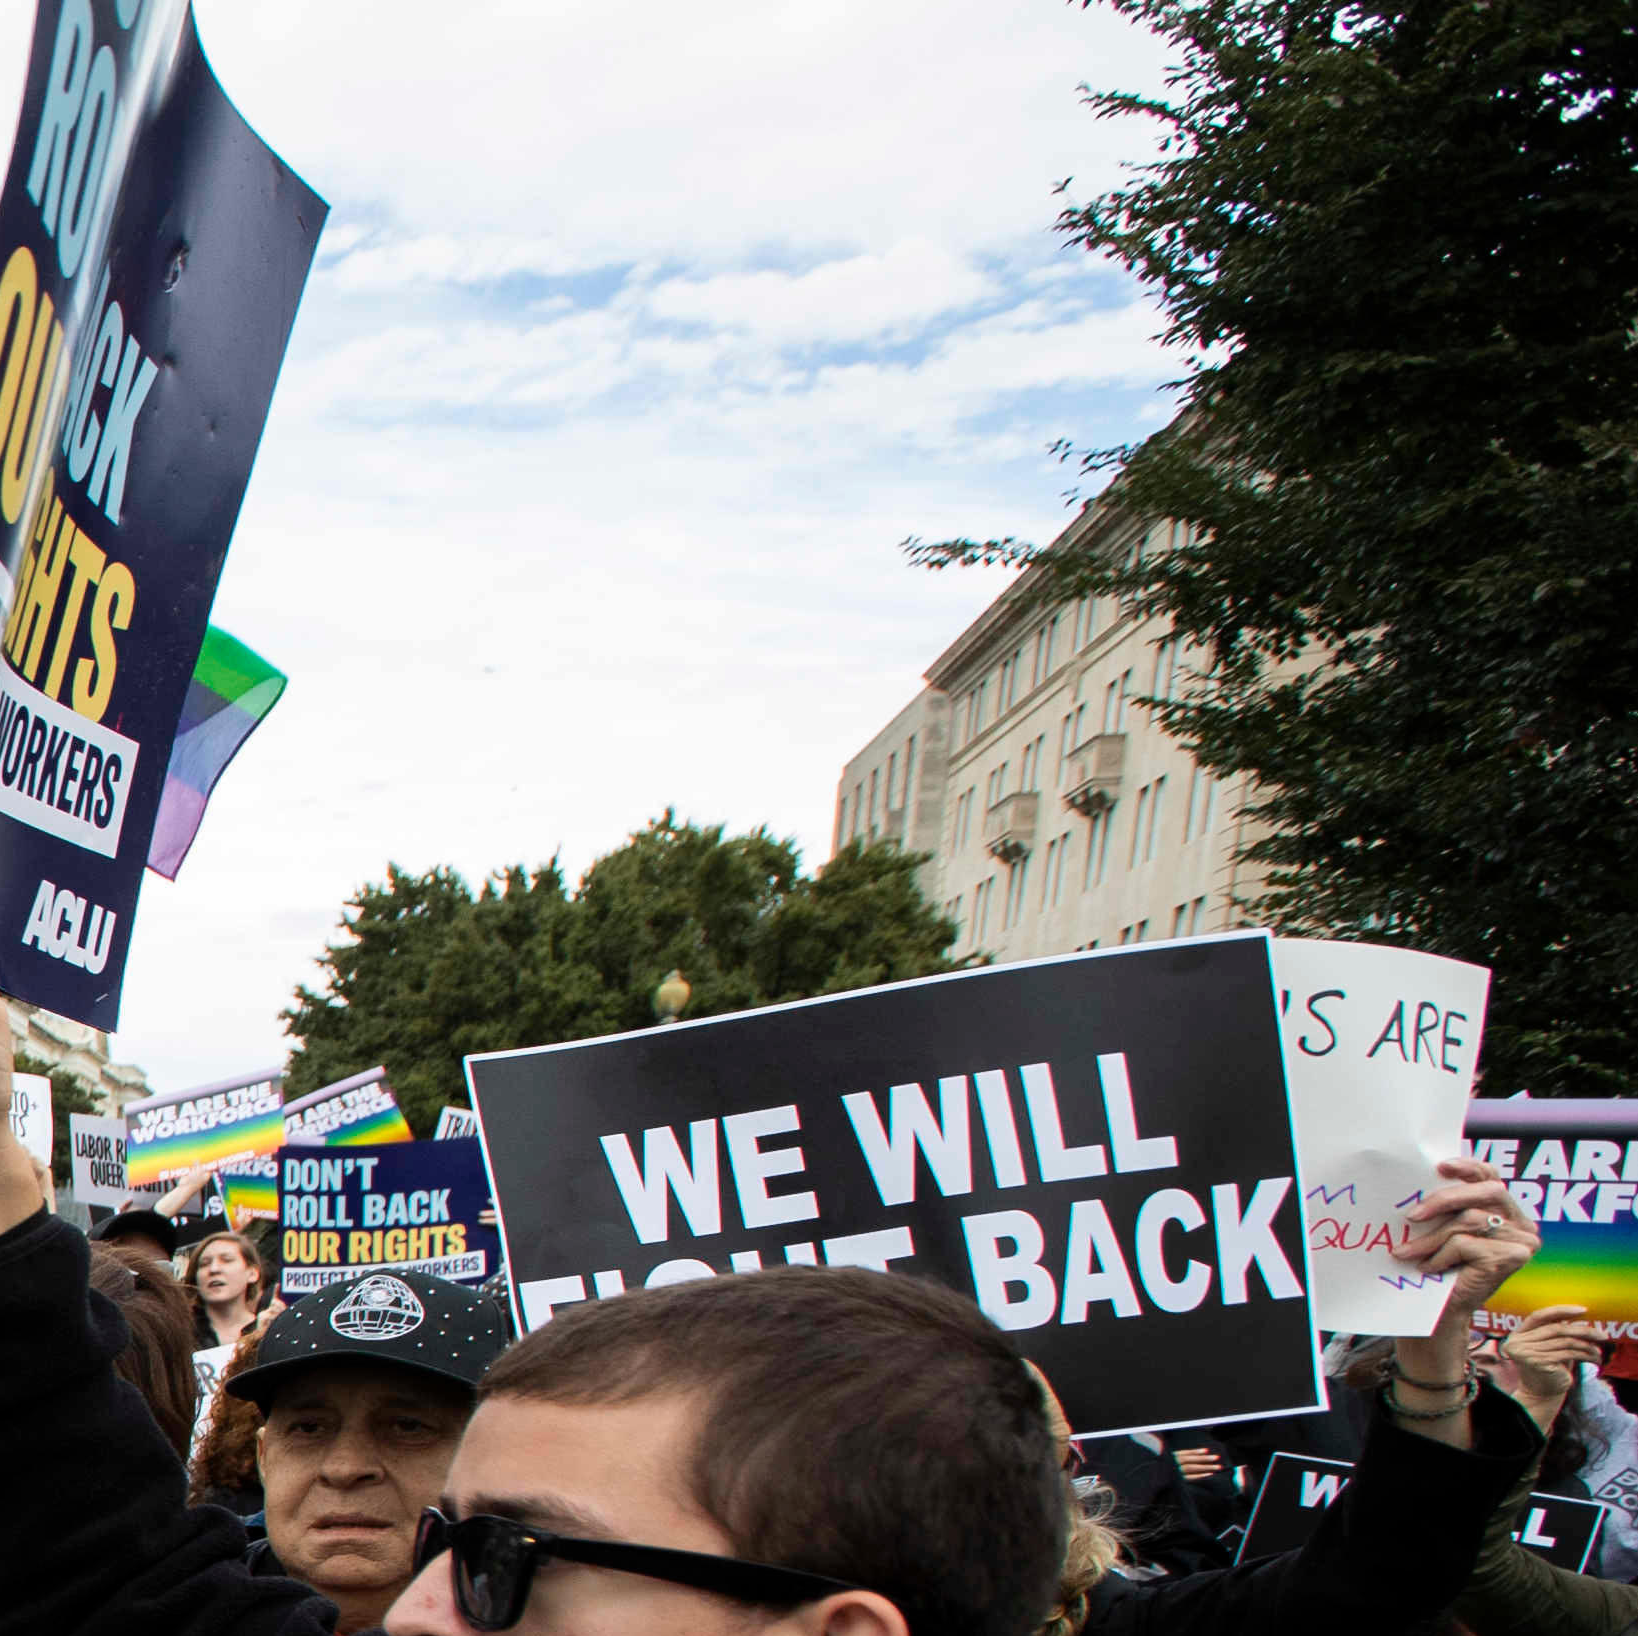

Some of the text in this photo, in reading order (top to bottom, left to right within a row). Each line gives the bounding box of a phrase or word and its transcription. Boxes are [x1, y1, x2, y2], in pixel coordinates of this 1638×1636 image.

[22, 880, 116, 975] ACLU
[1366, 1000, 1467, 1075] ARE
[131, 1093, 280, 1144] WORKFORCE
[137, 1081, 271, 1127] WE ARE THE
[75, 1133, 113, 1161] LABOR
[600, 1052, 1179, 1245] WE WILL
[90, 1160, 125, 1189] QUEER
[283, 1157, 379, 1192] DON'T
[283, 1194, 353, 1228] ROLL
[362, 1188, 452, 1227] BACK
[283, 1223, 467, 1264] OUR RIGHTS
[962, 1176, 1305, 1332] BACK
[286, 1270, 349, 1288] PROTECT
